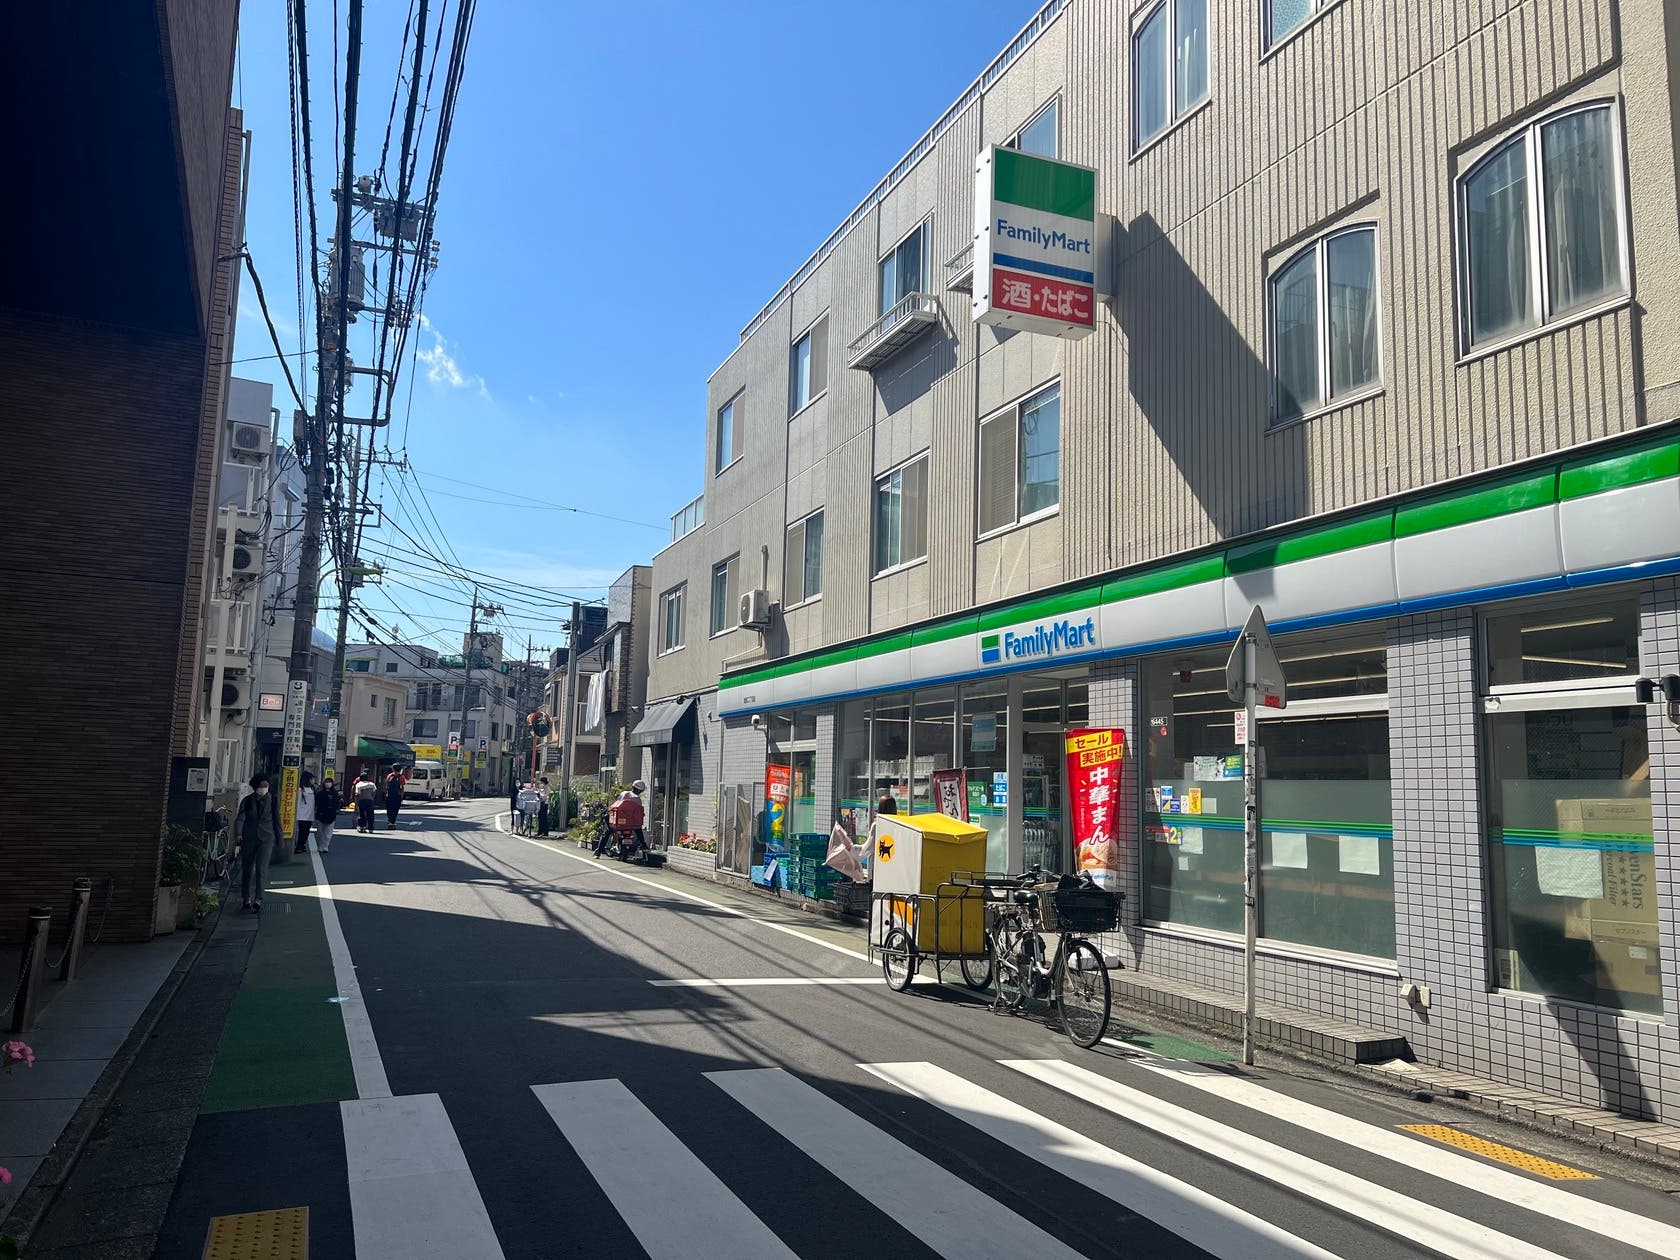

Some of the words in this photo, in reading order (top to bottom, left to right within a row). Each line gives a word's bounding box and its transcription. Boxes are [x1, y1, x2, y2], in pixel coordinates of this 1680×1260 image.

[997, 219, 1091, 254] FamilyMart
[1002, 278, 1088, 318] 酒・たばこ
[1004, 616, 1095, 659] FamilyMart
[1075, 734, 1109, 749] セール
[1082, 745, 1122, 765] 実施中!
[1089, 767, 1110, 845] 中華まん
